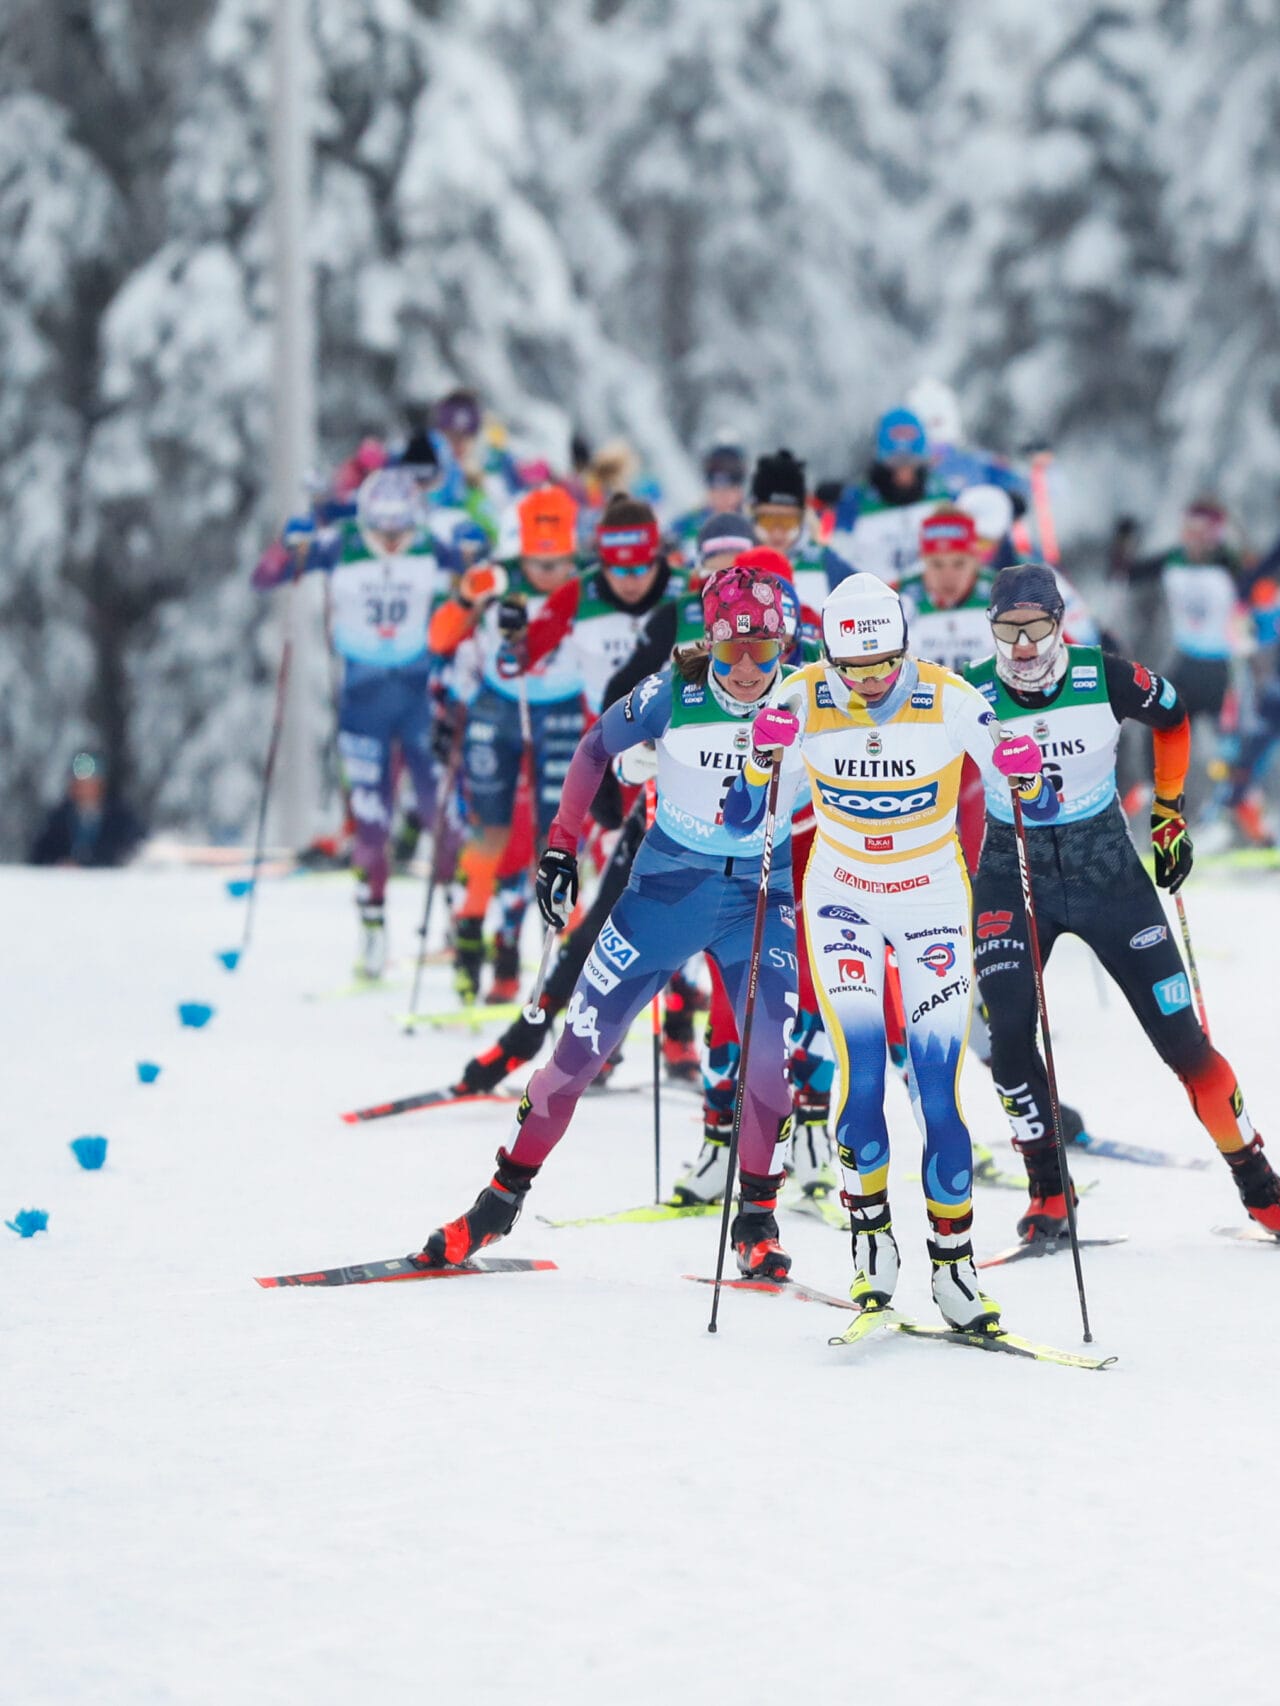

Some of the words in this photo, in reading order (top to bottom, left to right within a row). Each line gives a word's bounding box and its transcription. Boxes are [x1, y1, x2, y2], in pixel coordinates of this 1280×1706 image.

[857, 617, 891, 628] SVENSKA
[858, 626, 878, 635] SPEL
[1073, 680, 1097, 689] coop
[912, 696, 934, 706] coop
[1040, 739, 1086, 758] TINS
[700, 750, 747, 771] VELT
[834, 758, 916, 778] VELTINS
[820, 788, 933, 813] coop
[904, 926, 959, 941] Sundström
[823, 942, 873, 959] SCANIA
[916, 953, 946, 965] Thermia
[981, 961, 1020, 977] TERREX
[829, 985, 864, 996] SVENSKA
[912, 982, 961, 1024] CRAFT
